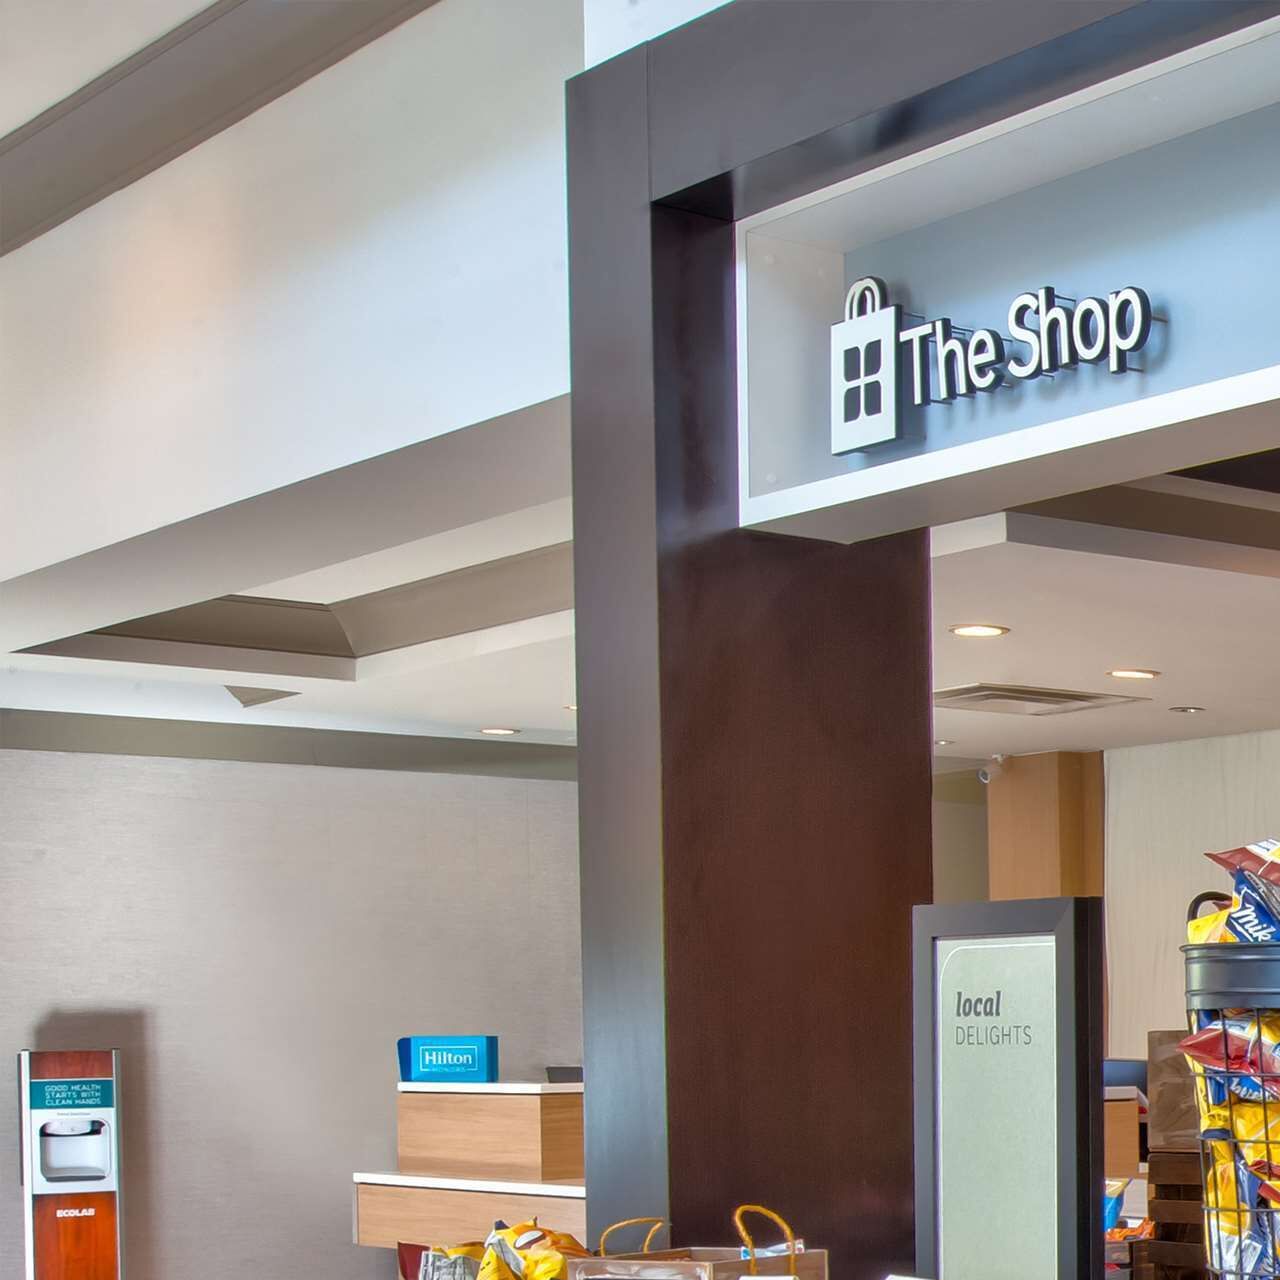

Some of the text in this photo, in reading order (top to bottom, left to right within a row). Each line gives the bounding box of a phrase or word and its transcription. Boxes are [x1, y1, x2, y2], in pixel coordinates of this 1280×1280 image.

[899, 285, 1151, 406] The Shop
[955, 990, 1001, 1017] local
[955, 1024, 1032, 1045] DELIGHTS
[424, 1051, 473, 1065] Hilton
[44, 1083, 101, 1092] GOOD HEALTH
[45, 1091, 77, 1099] STARTS
[56, 1207, 96, 1218] ECOLAB
